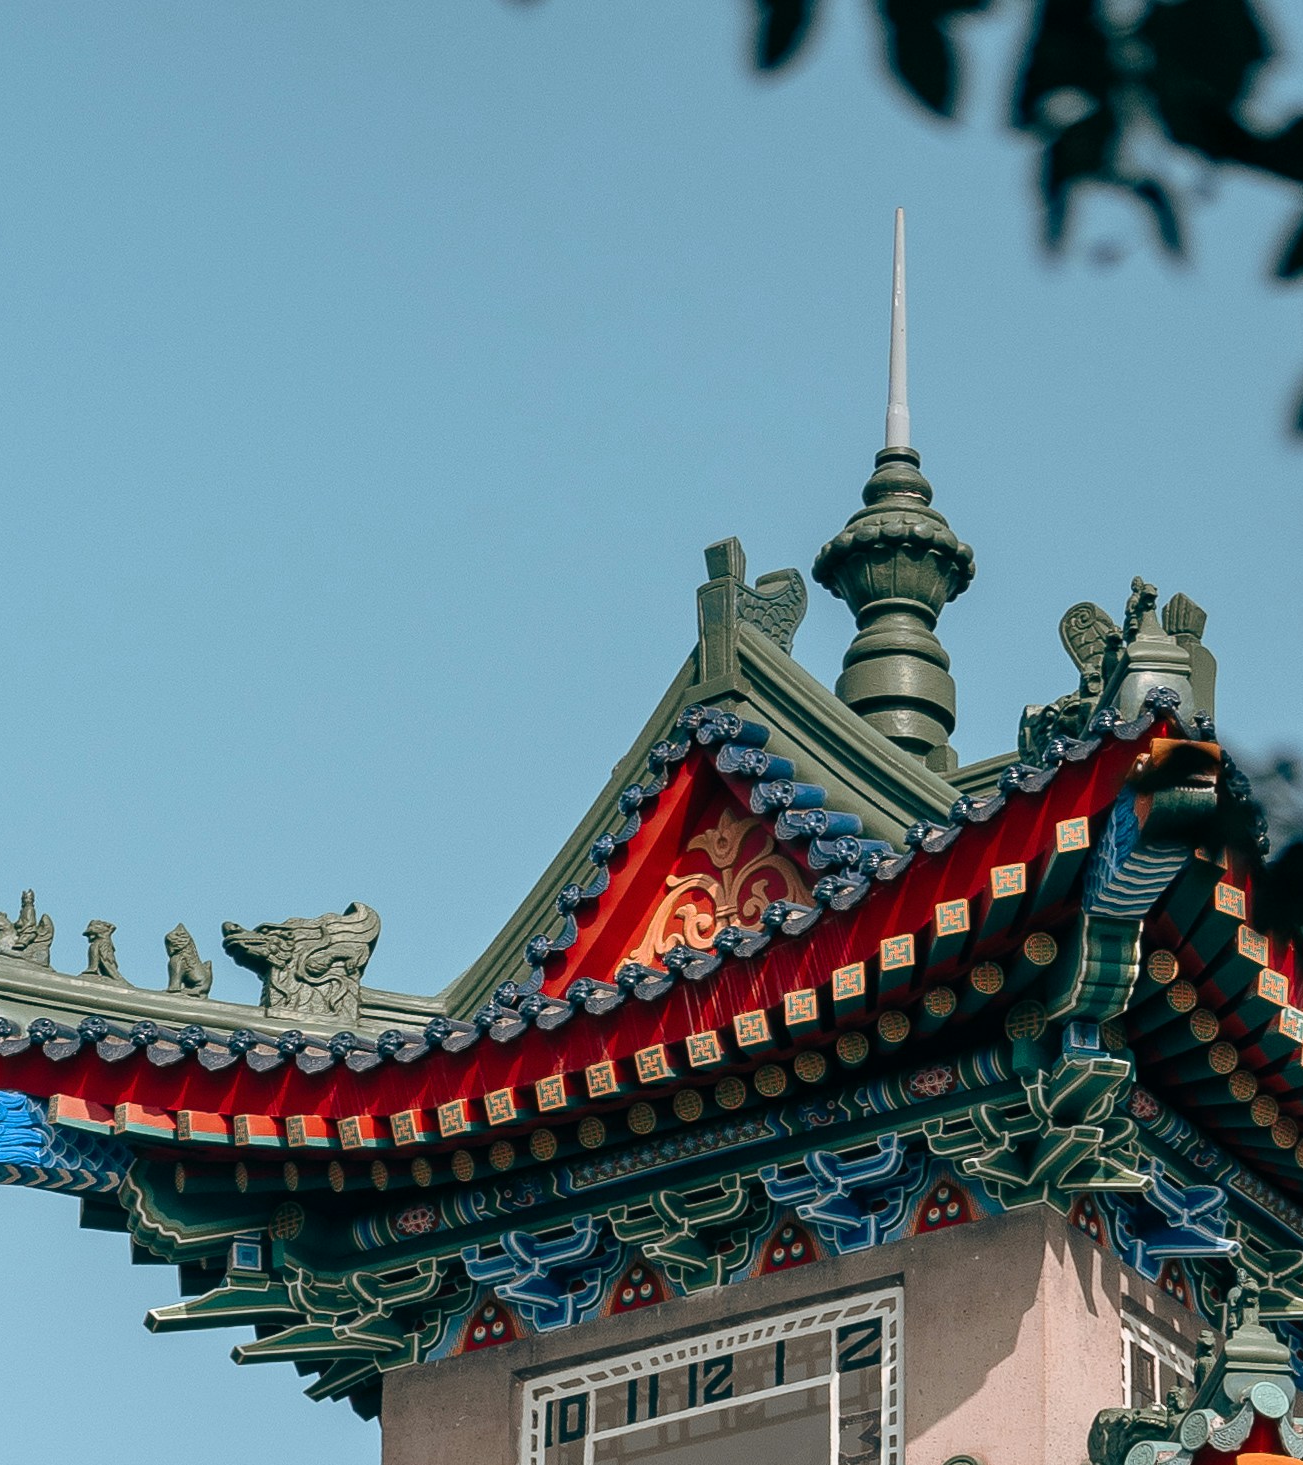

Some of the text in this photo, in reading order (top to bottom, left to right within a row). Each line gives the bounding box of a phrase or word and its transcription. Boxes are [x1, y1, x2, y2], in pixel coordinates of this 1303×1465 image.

[545, 1318, 882, 1447] 10 11 12 1 2
